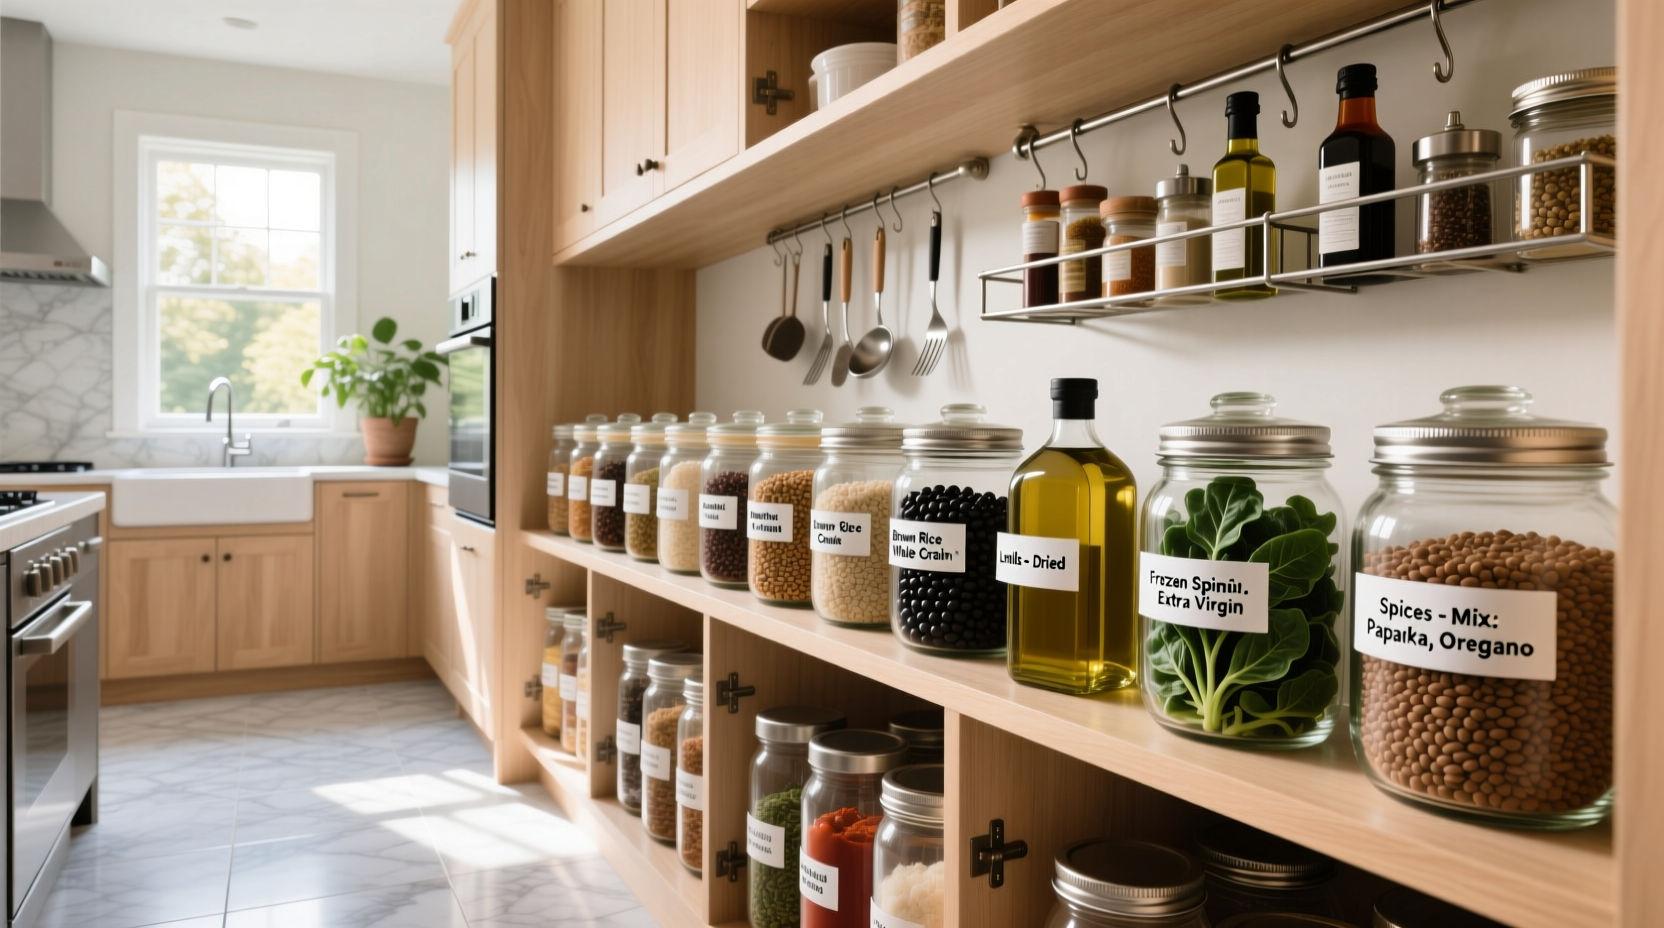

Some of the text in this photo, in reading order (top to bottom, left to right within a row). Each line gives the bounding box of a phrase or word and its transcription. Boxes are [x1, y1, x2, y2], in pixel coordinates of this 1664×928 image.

[1033, 554, 1066, 570] Dried
[1150, 570, 1188, 589] Frozen
[1158, 590, 1244, 617] Extra Virgin
[1379, 597, 1432, 621] Spices
[1451, 607, 1498, 629] Mix:
[1439, 632, 1534, 659] Oregano
